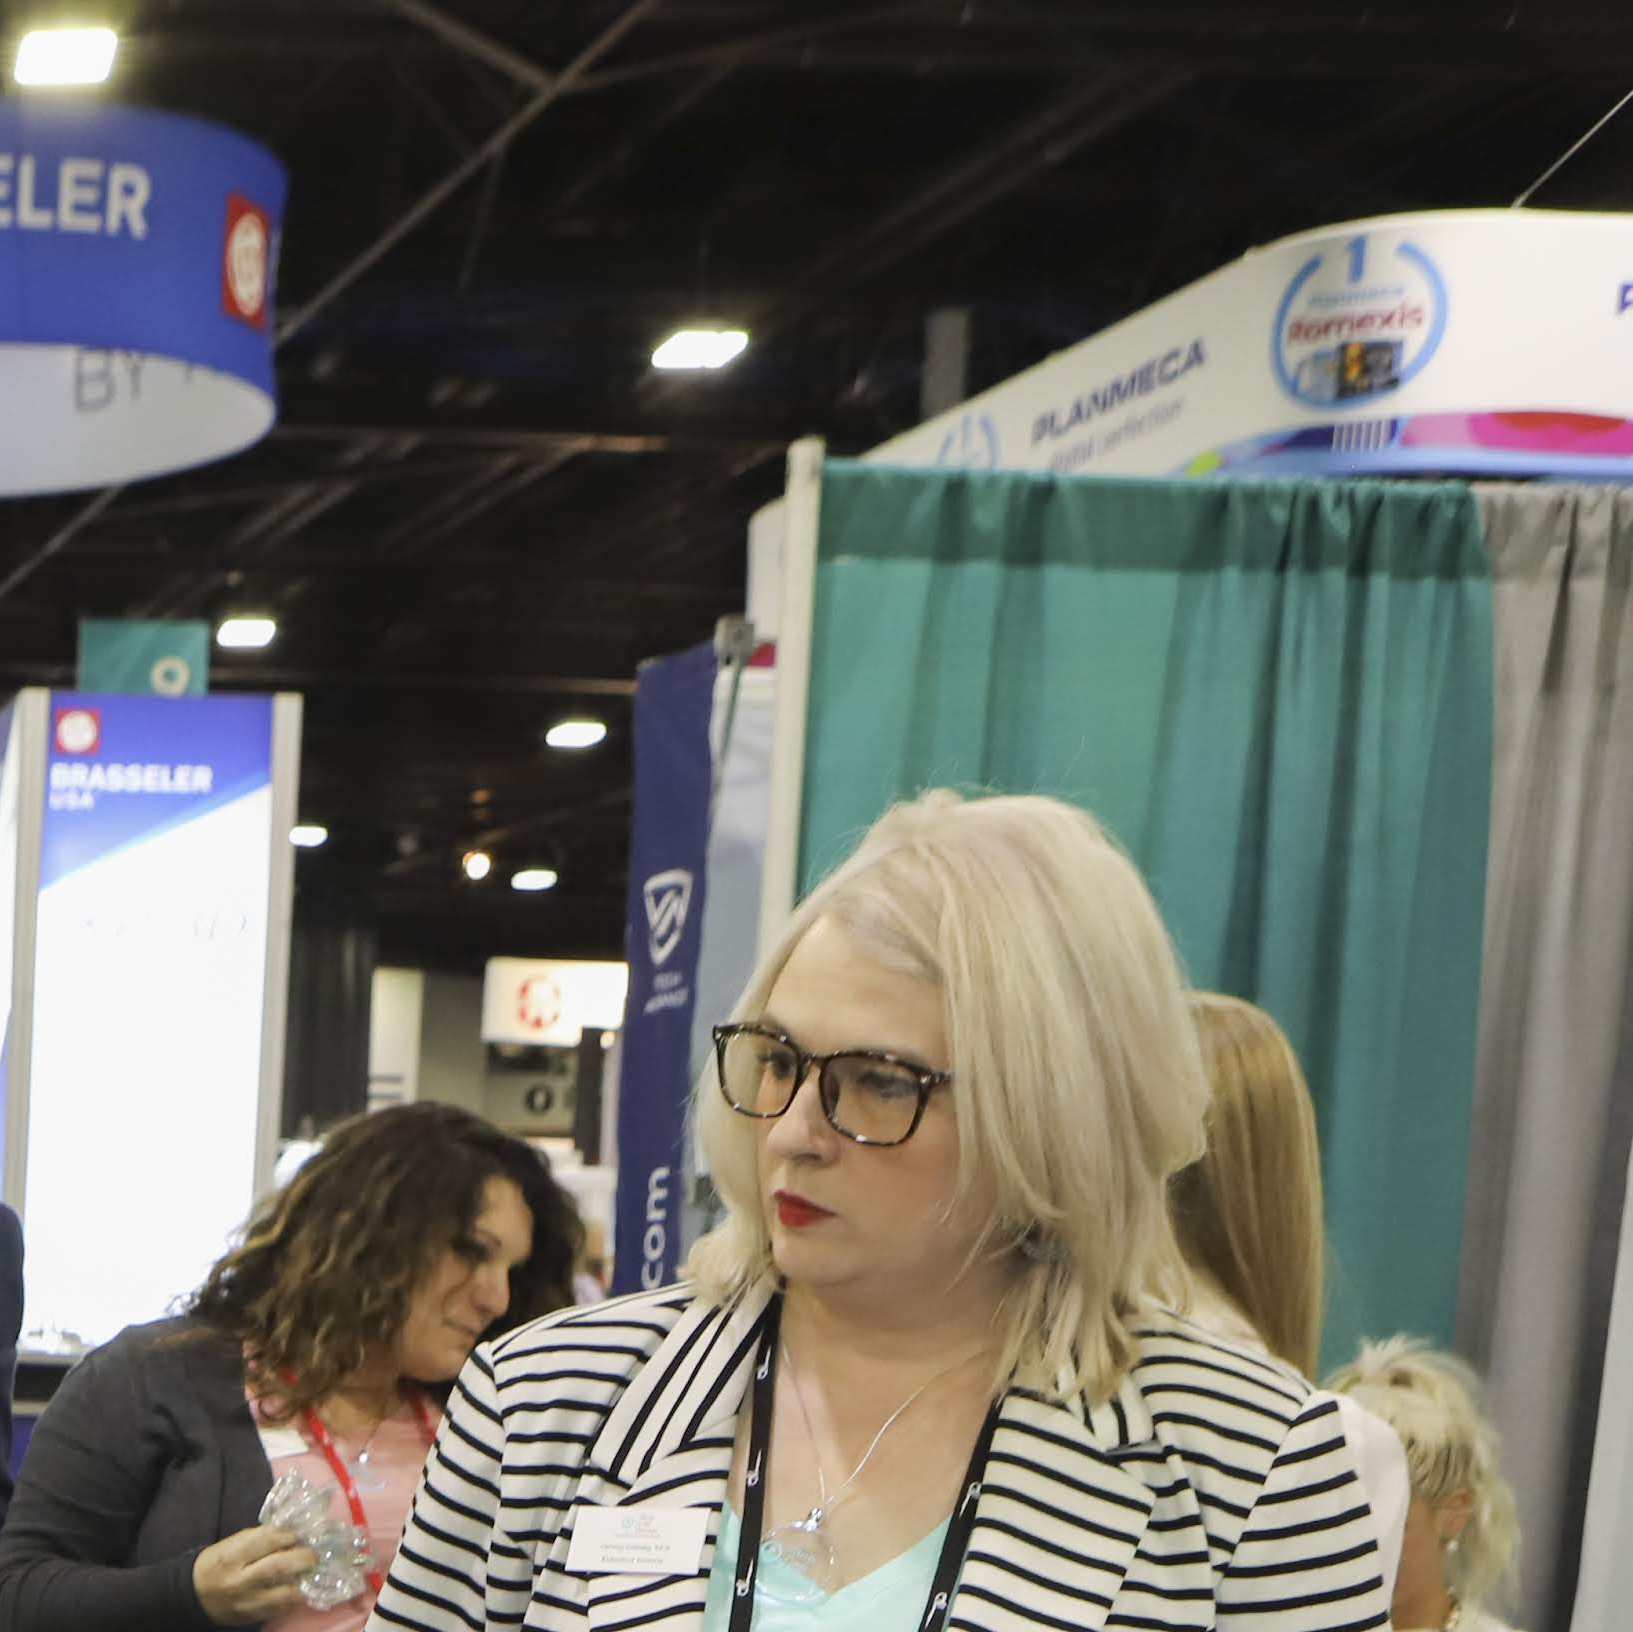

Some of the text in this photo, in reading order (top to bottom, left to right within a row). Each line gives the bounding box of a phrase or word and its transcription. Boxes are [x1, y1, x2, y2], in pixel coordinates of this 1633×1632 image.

[1287, 301, 1425, 345] Romexis
[72, 344, 147, 413] BY
[1032, 336, 1207, 446] PLANMECA
[49, 762, 214, 793] BRASSELER
